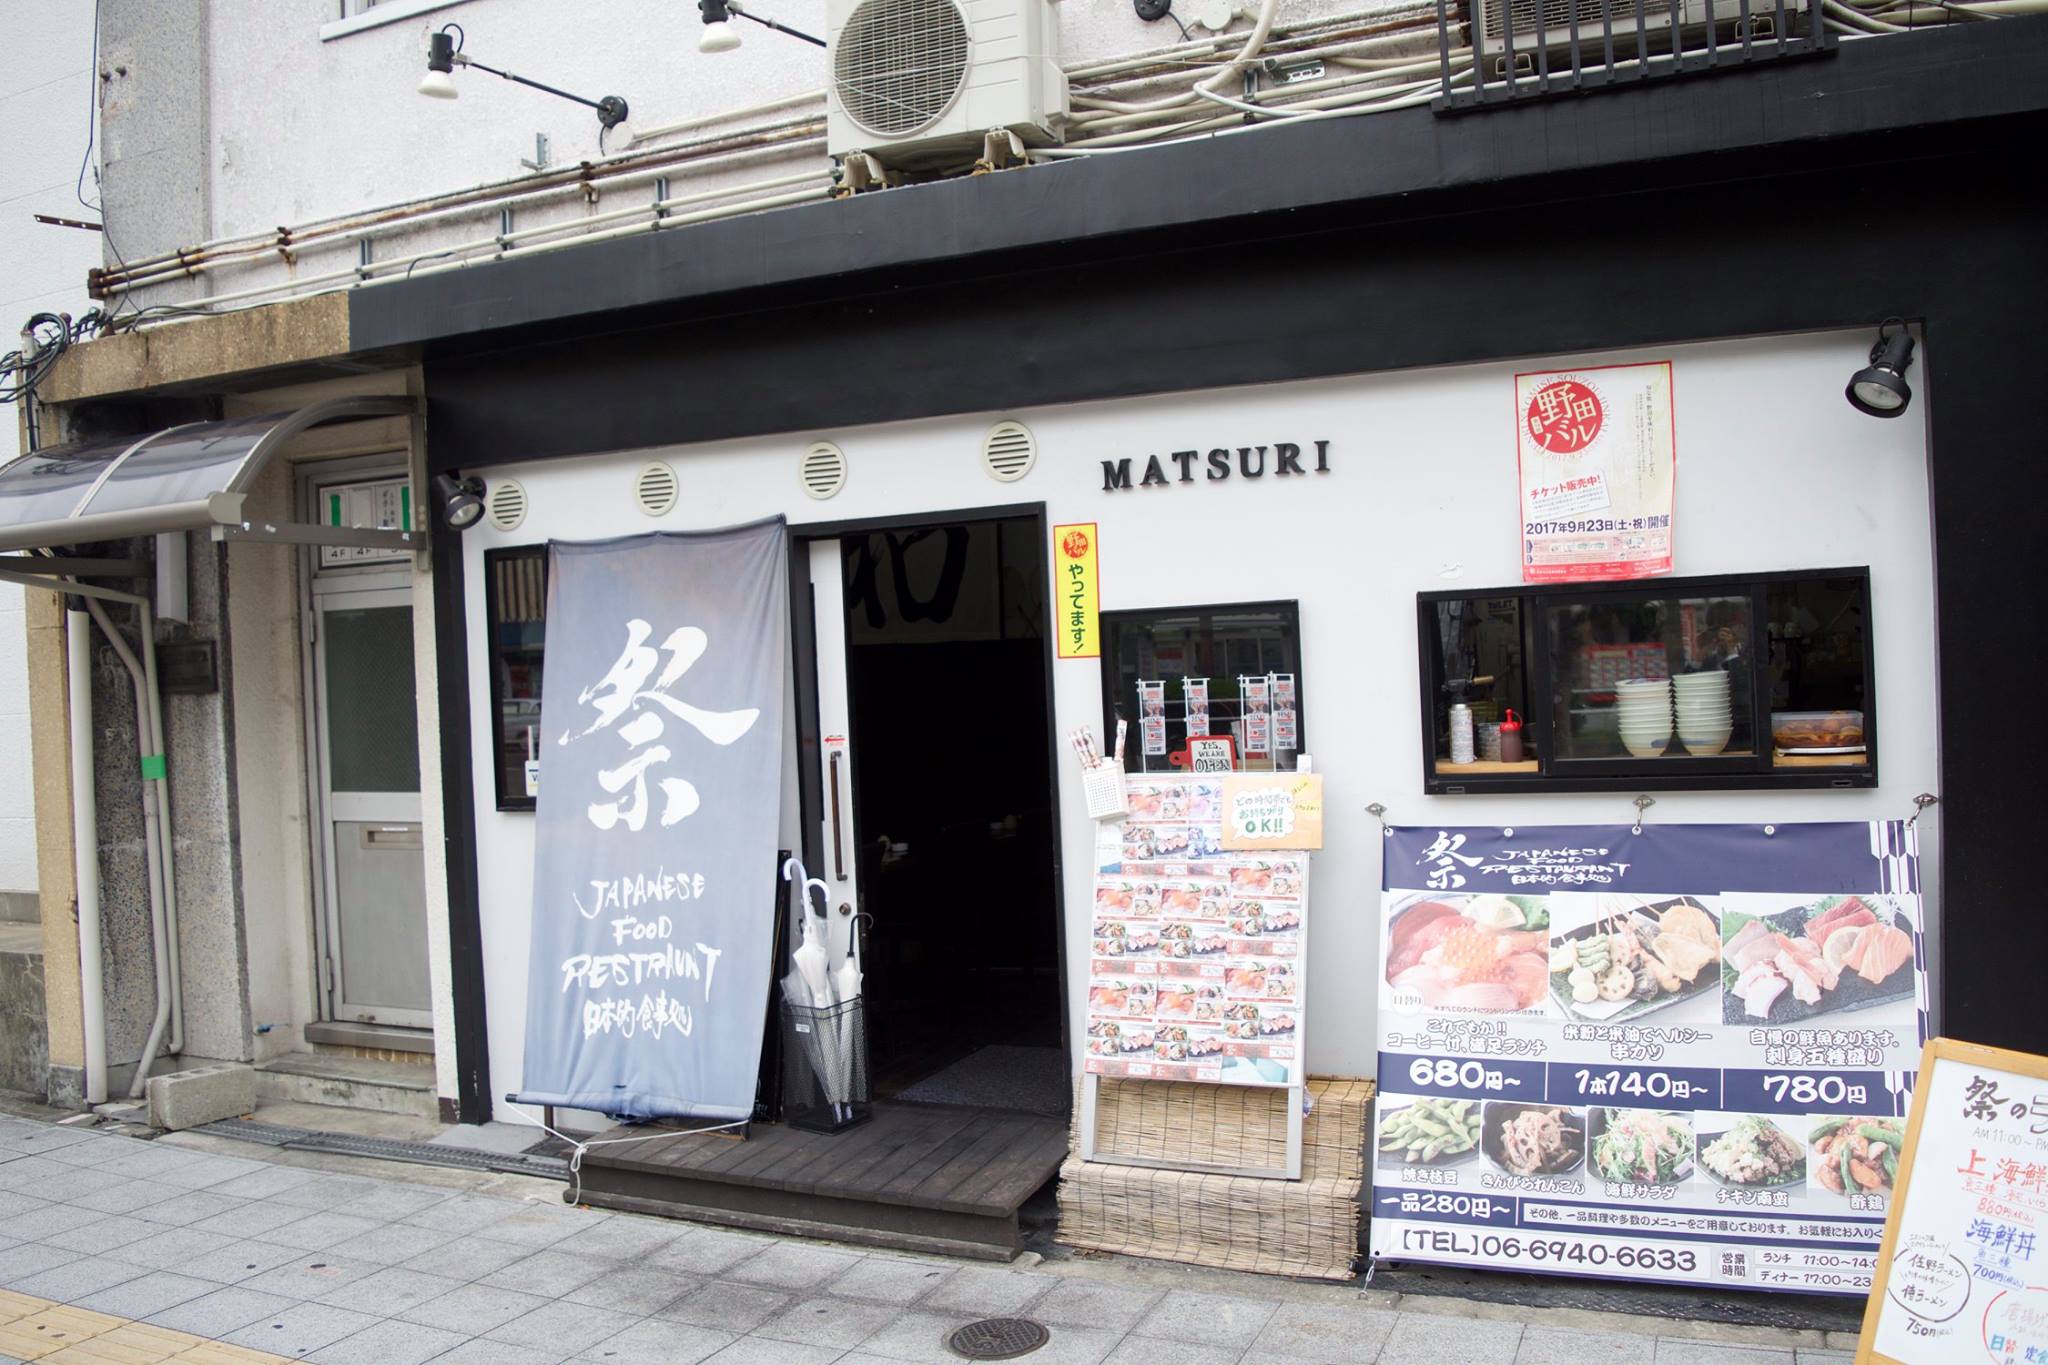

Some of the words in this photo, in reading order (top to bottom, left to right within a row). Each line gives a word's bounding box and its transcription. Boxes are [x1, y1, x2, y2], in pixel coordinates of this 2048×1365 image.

[1536, 383, 1597, 426] 野田
[1543, 420, 1597, 448] バル
[1101, 440, 1331, 491] MATSURI
[1068, 563, 1085, 654] やってます!
[558, 618, 760, 831] 祭
[1416, 831, 1484, 889] 祭
[573, 865, 705, 919] JAPANESE
[1750, 1029, 1899, 1049] 自慢の鮮魚あります。
[1611, 1043, 1664, 1061] 串カツ
[1766, 1047, 1884, 1067] 刺身五種盛り
[1763, 1075, 1867, 1104] 780円
[1402, 1168, 1457, 1185] 焼き枝豆
[1605, 1182, 1677, 1200] 海鮮サラダ
[1716, 1188, 1789, 1208] チキン南蛮
[1966, 1218, 2037, 1261] 海鮮丼
[1721, 1252, 1745, 1265] 営業
[1762, 1251, 1792, 1265] ランチ
[1721, 1265, 1746, 1278] 時間
